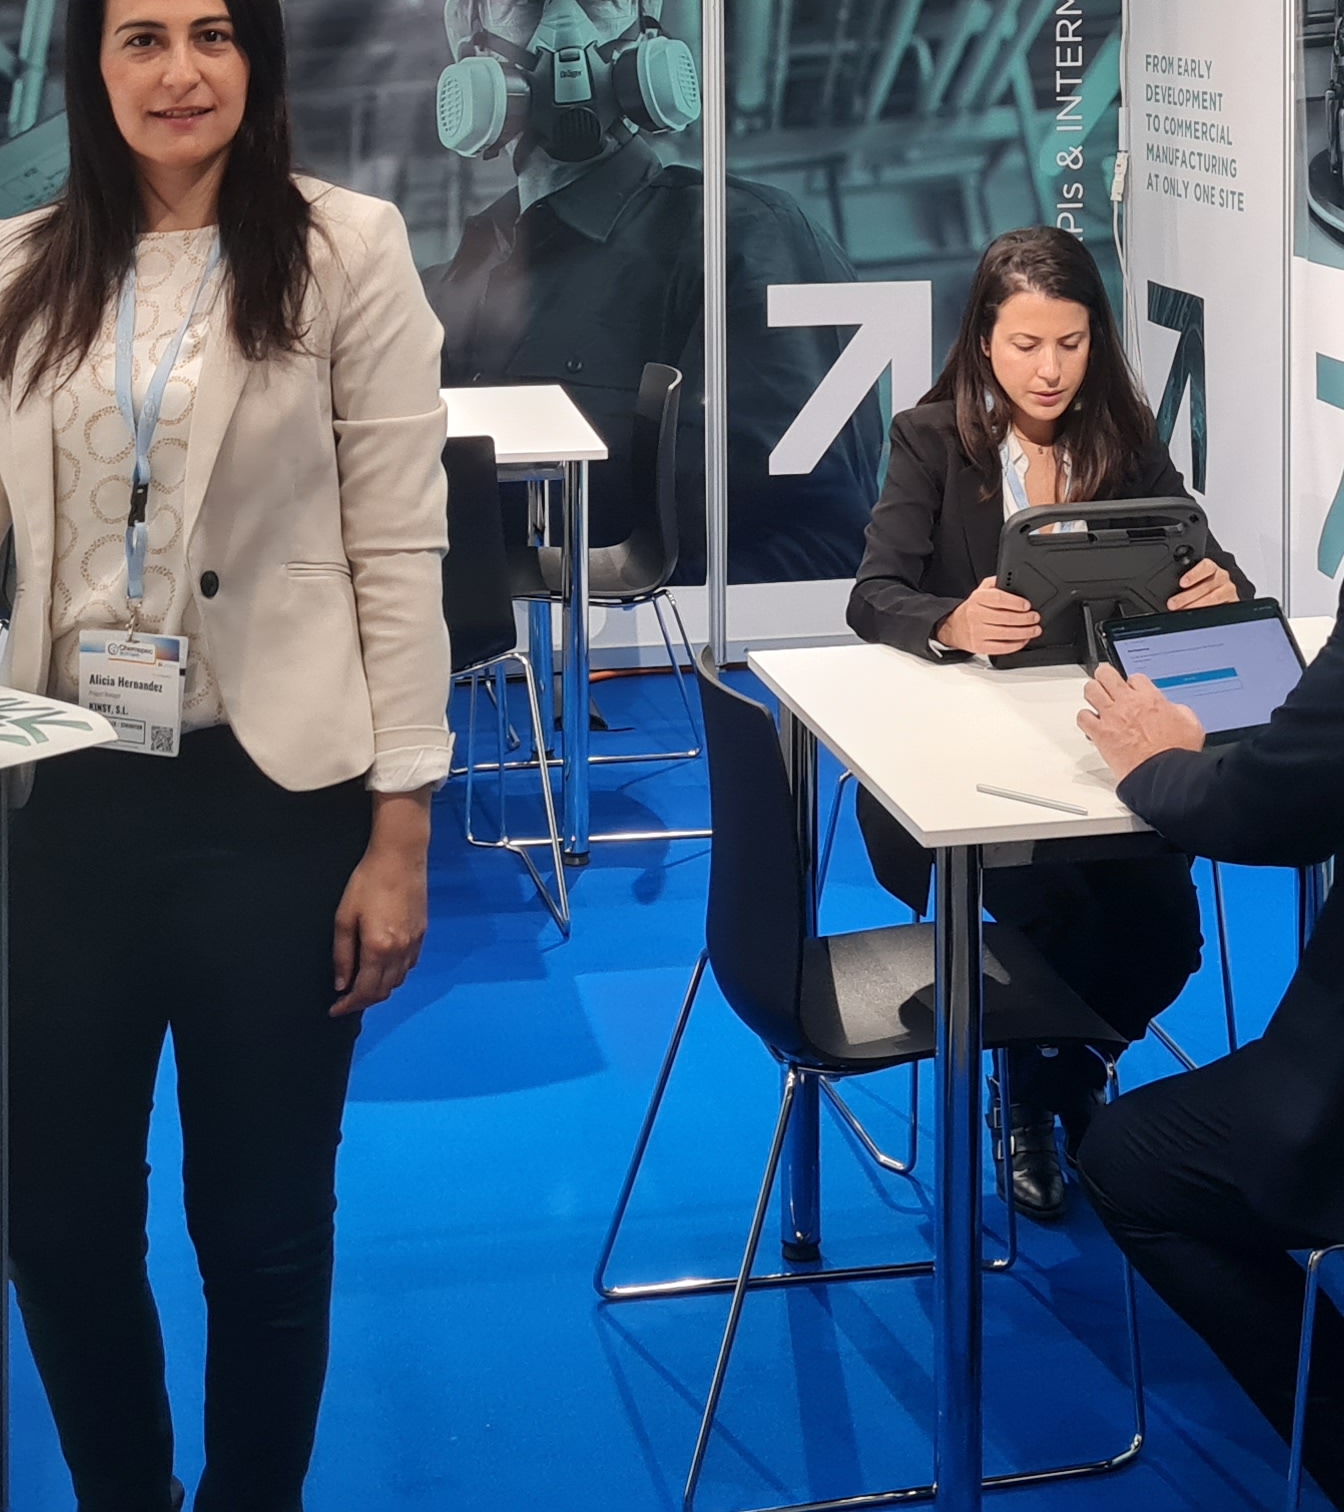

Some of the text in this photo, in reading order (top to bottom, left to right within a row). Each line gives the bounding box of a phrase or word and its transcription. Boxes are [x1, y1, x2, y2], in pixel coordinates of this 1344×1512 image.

[1145, 53, 1212, 79] FROM EARLY
[1145, 83, 1223, 112] DEVELOPMENT
[1145, 112, 1232, 146] TO COMMERCIAL
[1146, 142, 1236, 178] MANUFACTURING
[1146, 172, 1244, 212] AT ONLY ONE SITE
[1056, 182, 1084, 241] PIs
[89, 674, 163, 693] Alicia Hernandez
